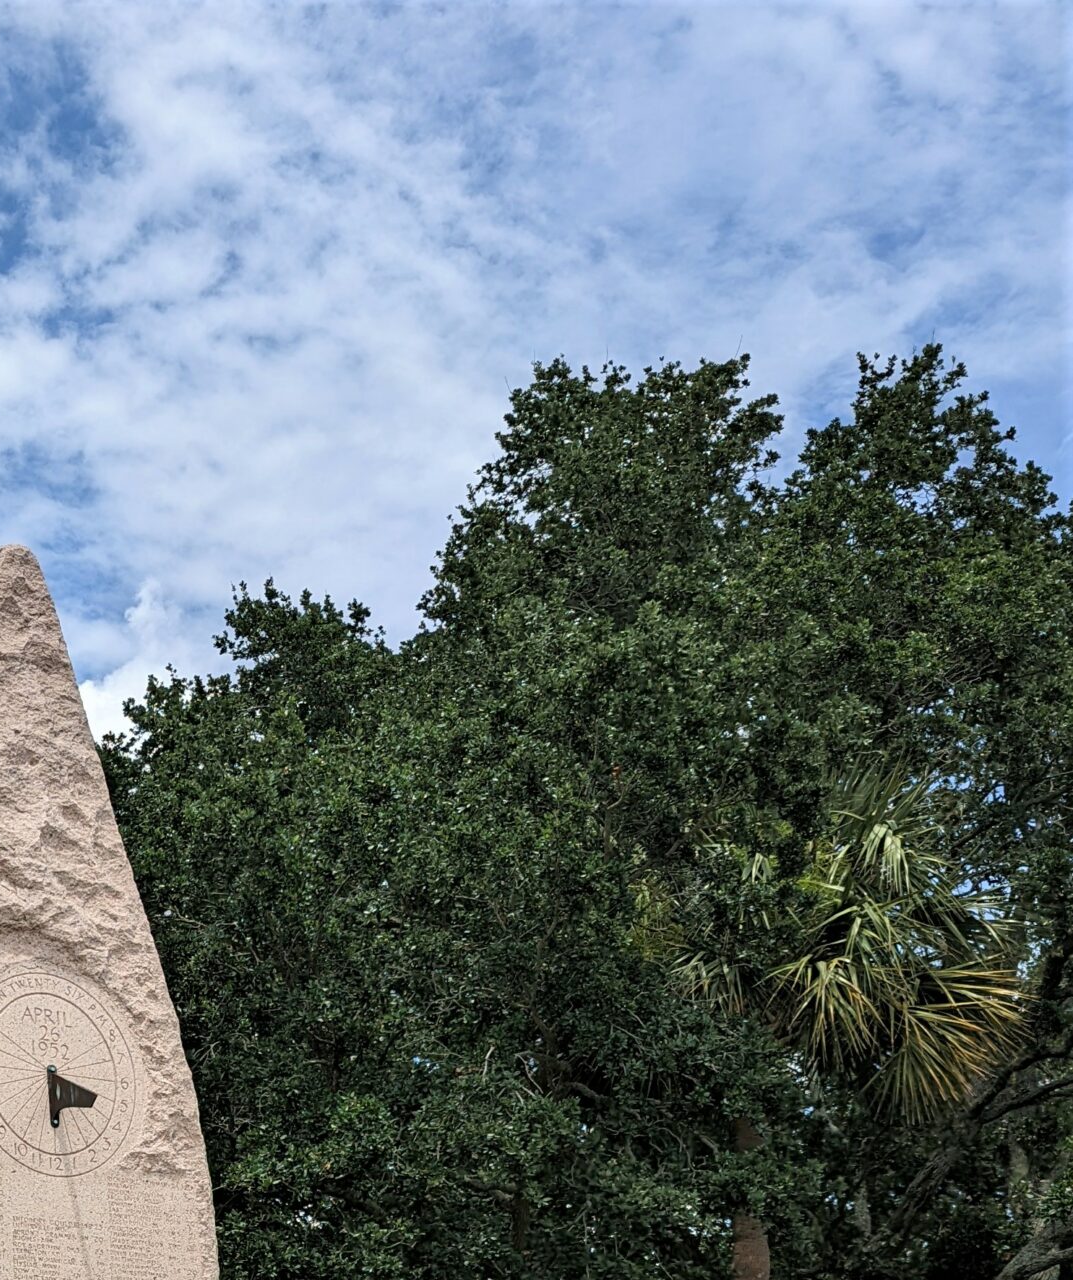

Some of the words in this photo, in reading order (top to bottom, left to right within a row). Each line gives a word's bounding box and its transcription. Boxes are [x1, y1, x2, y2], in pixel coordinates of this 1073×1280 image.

[9, 977, 59, 993] TWENTY
[88, 1004, 96, 1012] P
[96, 1014, 108, 1026] M
[21, 1006, 73, 1028] APRIL
[39, 1025, 60, 1043] 26
[108, 1029, 117, 1042] 8
[31, 1041, 70, 1060] 1952
[120, 1074, 129, 1090] 6
[120, 1100, 128, 1113] 5
[13, 1142, 28, 1157] 10
[102, 1137, 112, 1151] 3
[49, 1156, 63, 1171] 12
[88, 1150, 97, 1163] 2
